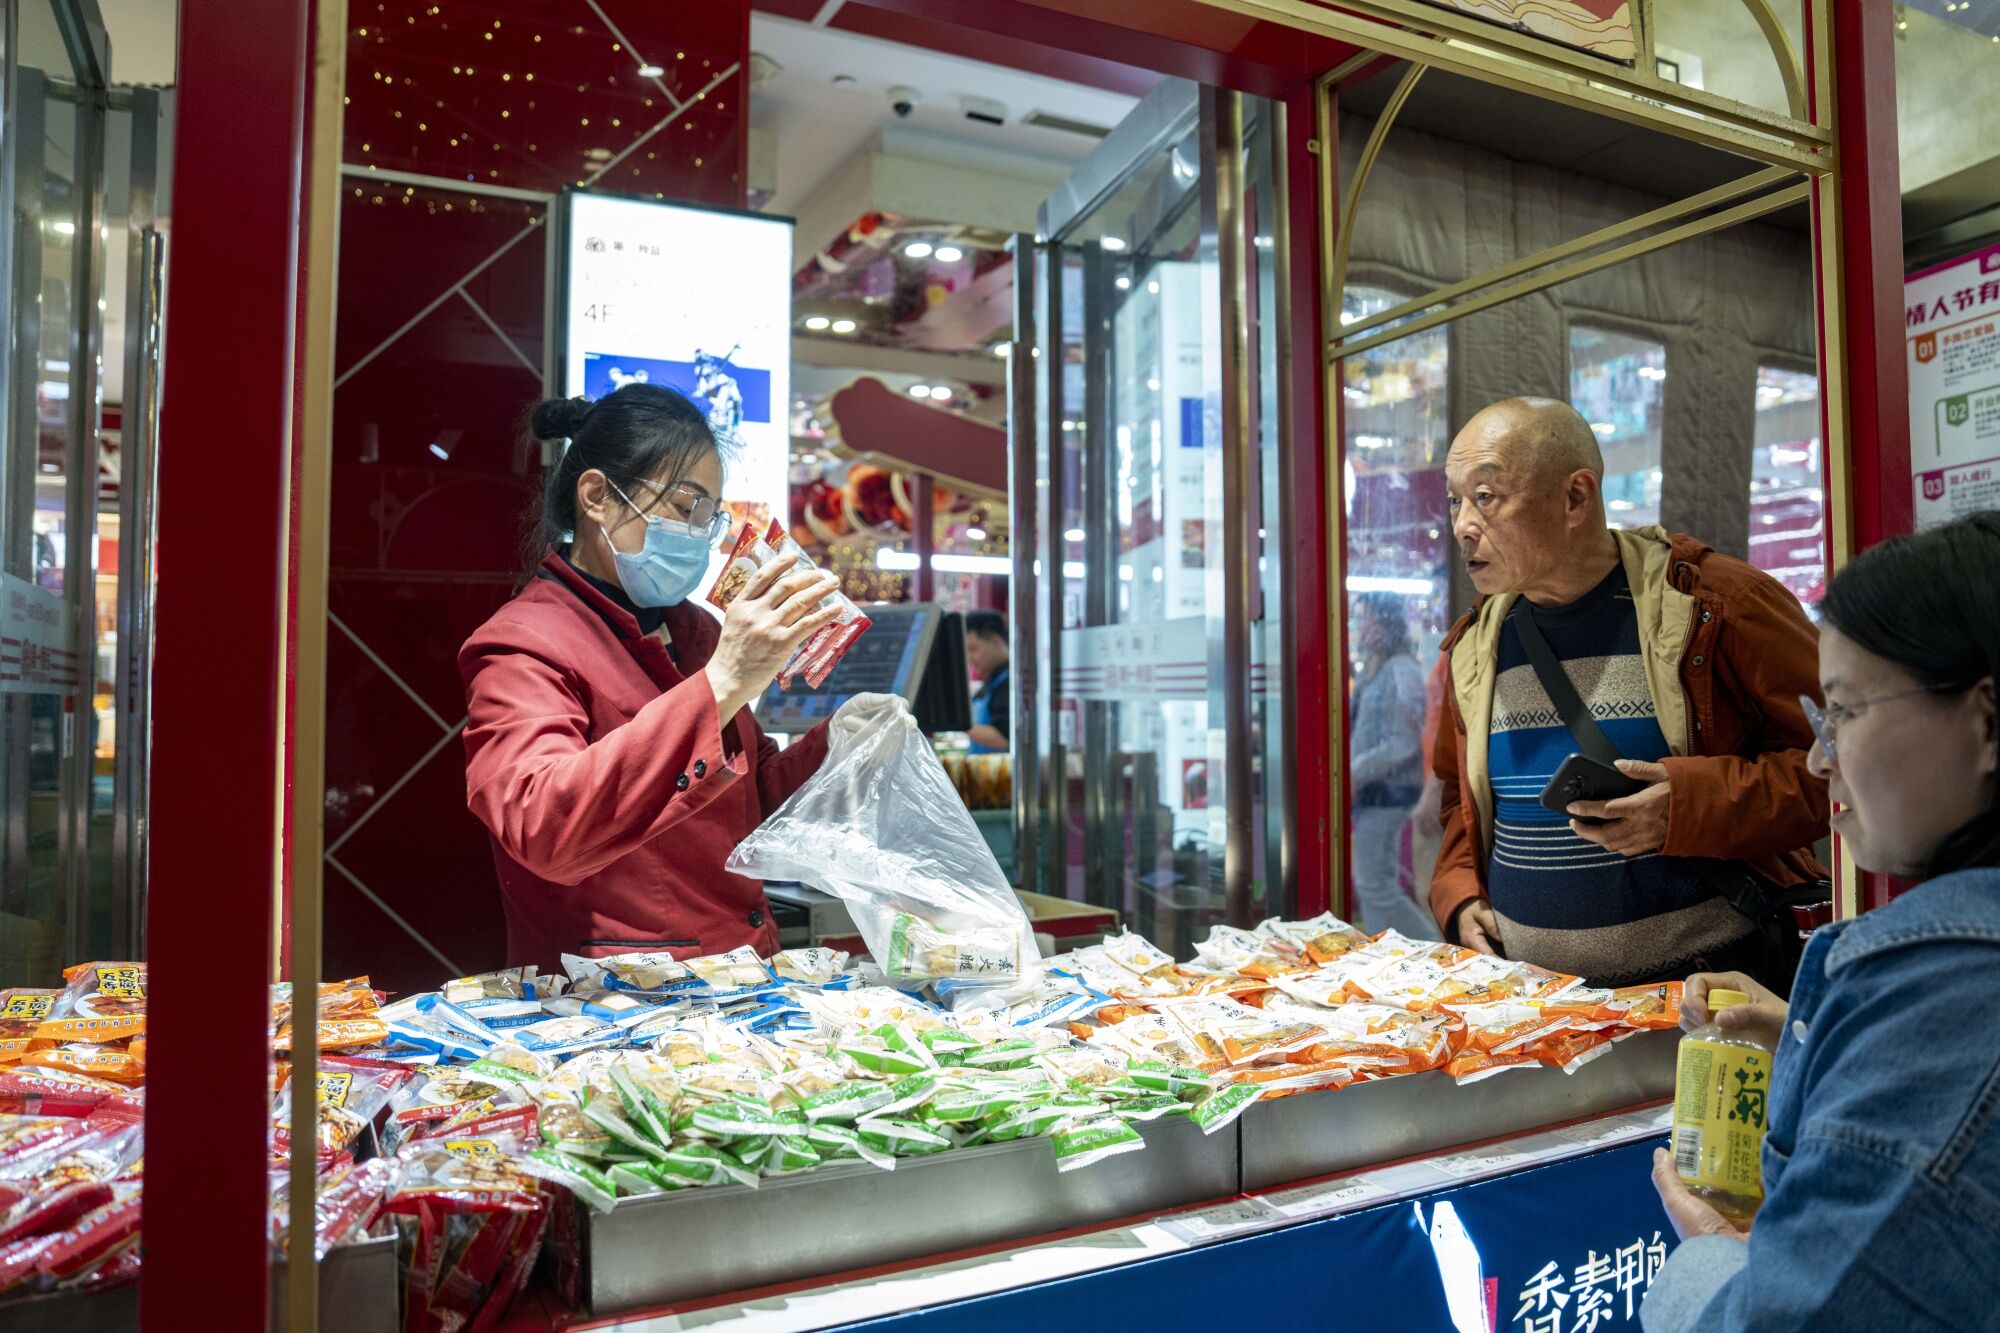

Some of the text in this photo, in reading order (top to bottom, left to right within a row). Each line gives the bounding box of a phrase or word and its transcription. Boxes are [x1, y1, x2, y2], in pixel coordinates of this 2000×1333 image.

[1906, 281, 2000, 328] 情人节有
[1918, 340, 1935, 358] 01
[1948, 402, 1968, 422] 02
[1923, 477, 1944, 497] 03
[1740, 1134, 1754, 1185] 菊花茶
